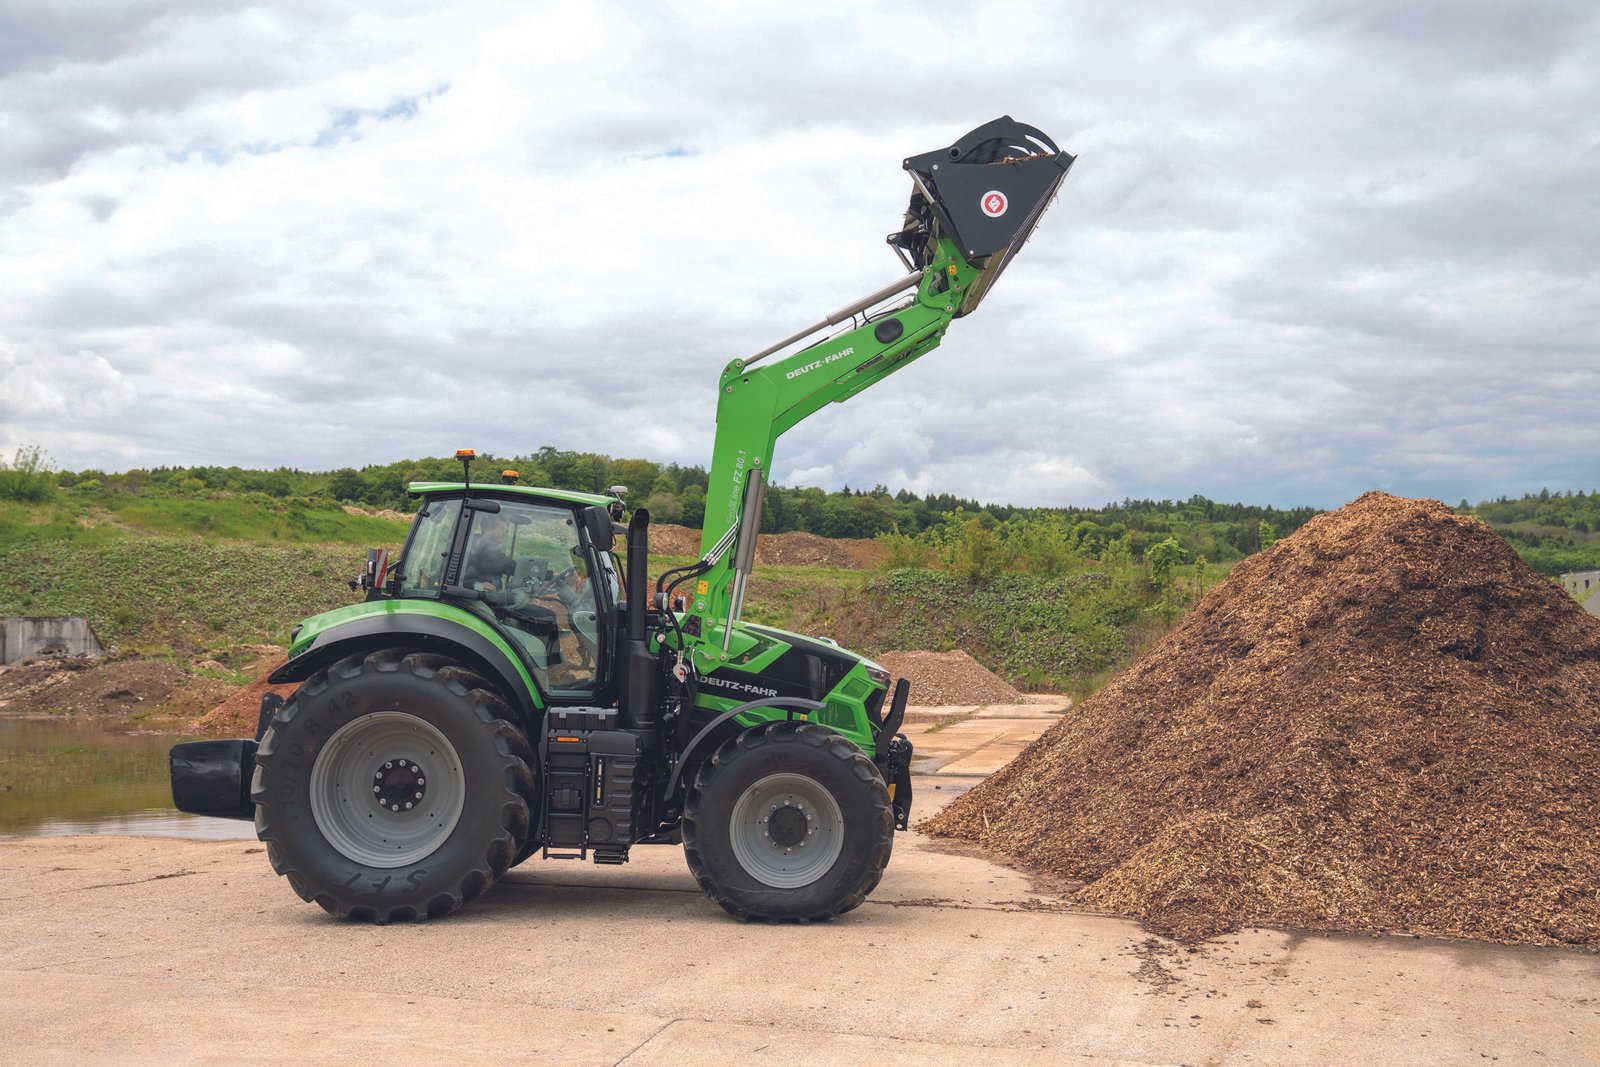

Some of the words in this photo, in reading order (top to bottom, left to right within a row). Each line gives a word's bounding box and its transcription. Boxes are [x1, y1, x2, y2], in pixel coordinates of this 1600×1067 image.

[786, 347, 854, 380] DEUTZ-FAHR
[736, 449, 746, 469] 80.1
[733, 470, 743, 484] FZ
[699, 676, 778, 697] DEUTZ-FAHR
[328, 691, 357, 714] 42
